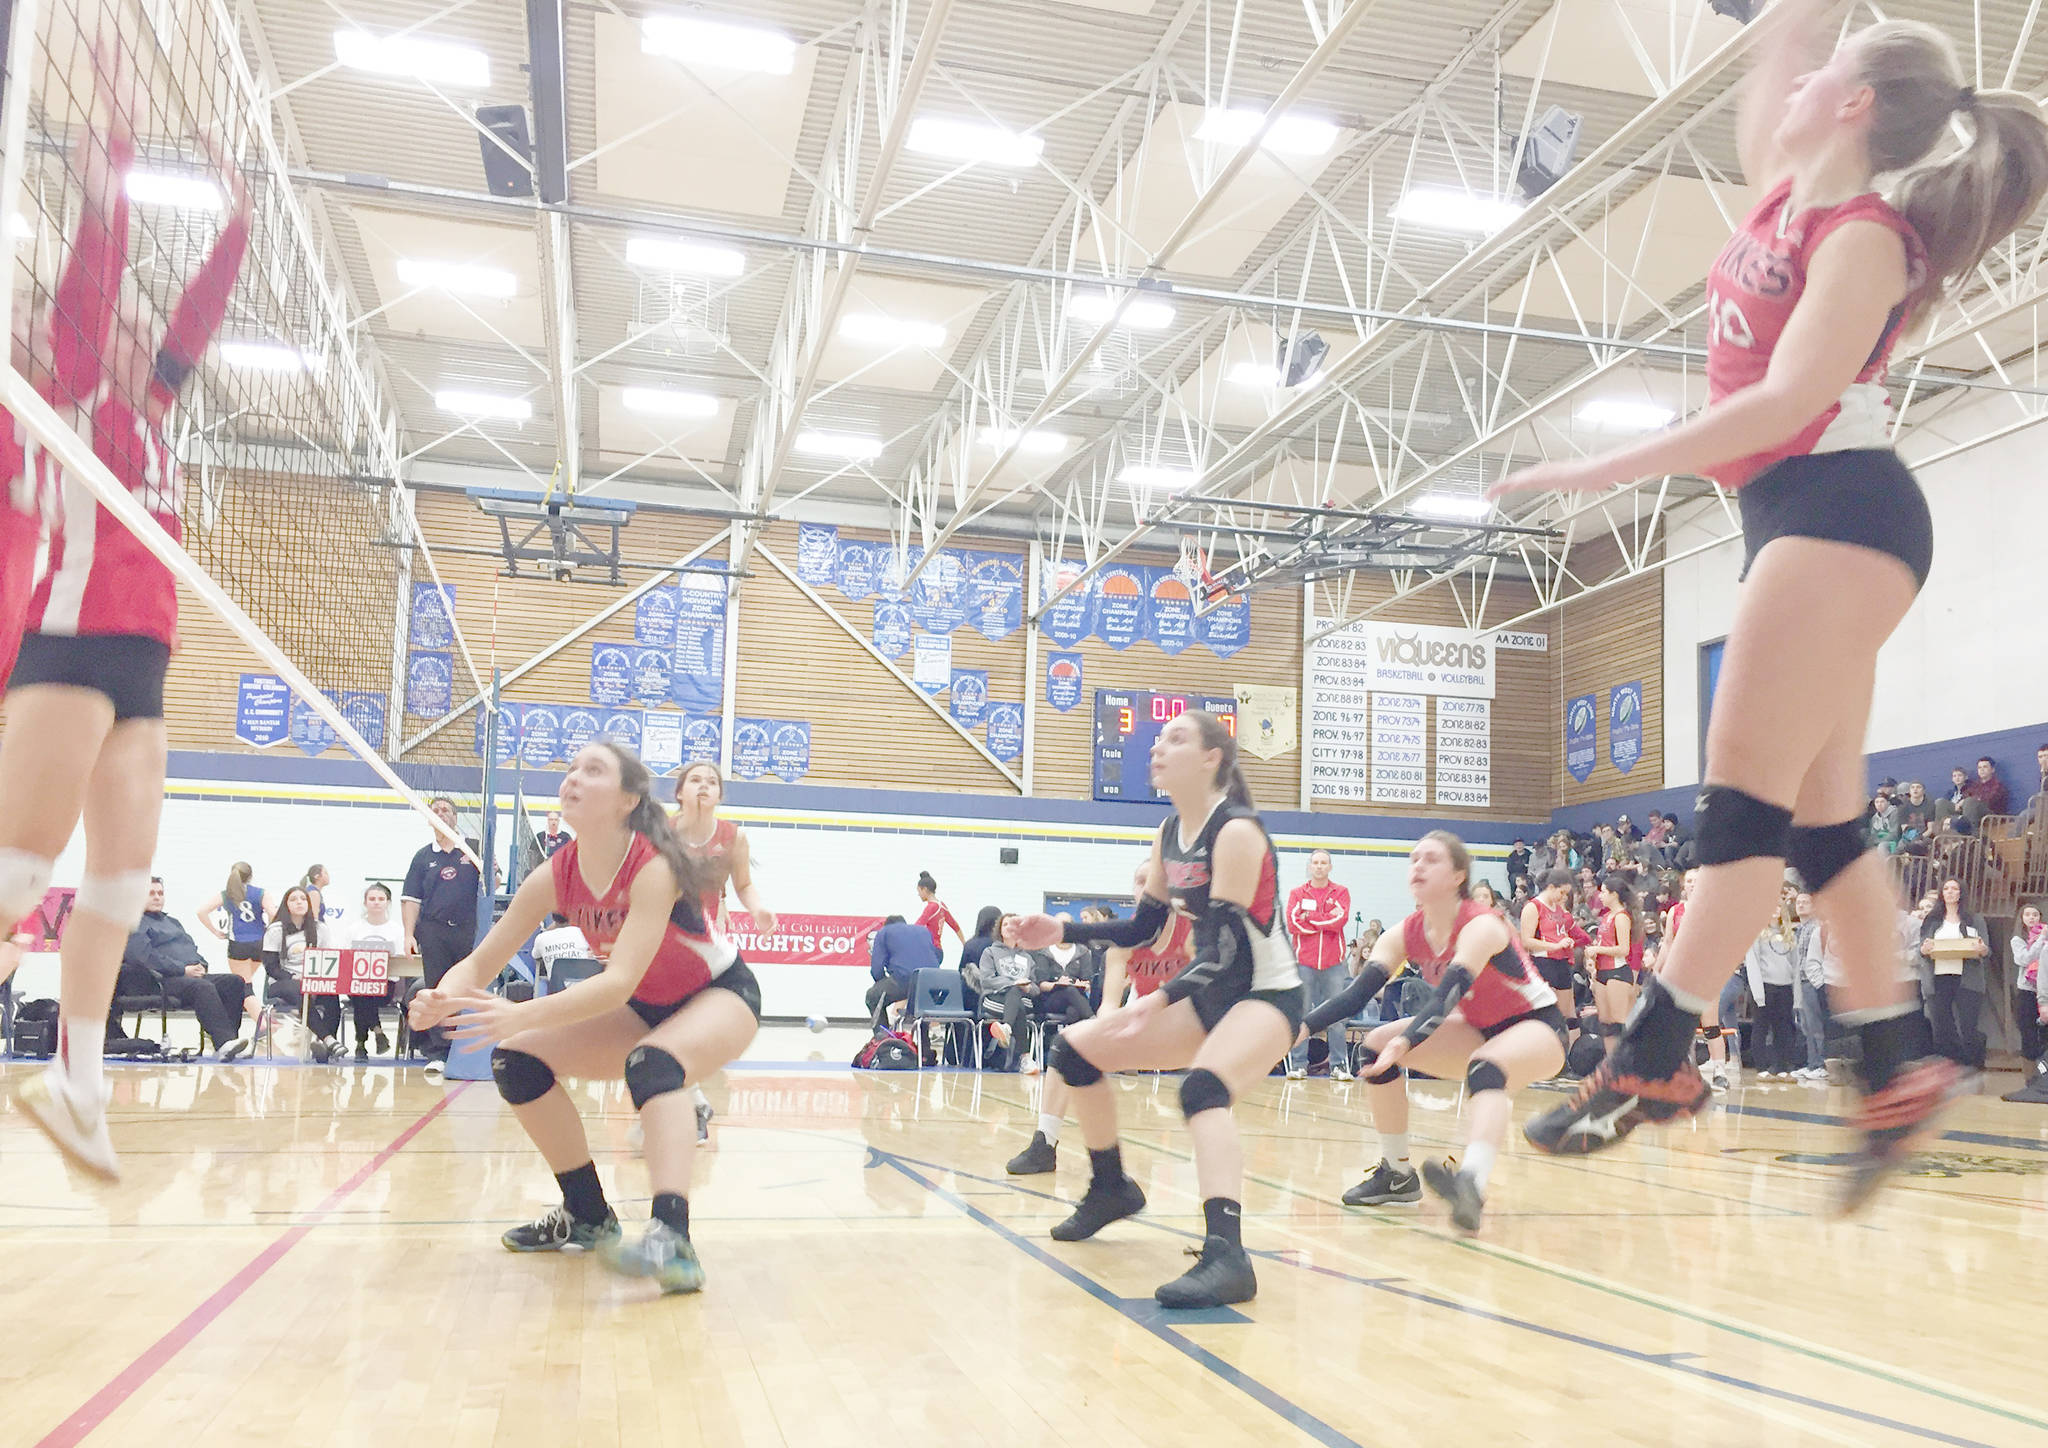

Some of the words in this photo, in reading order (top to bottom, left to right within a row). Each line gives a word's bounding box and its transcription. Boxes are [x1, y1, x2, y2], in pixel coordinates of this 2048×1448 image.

[1495, 634, 1509, 644] AA
[1511, 636, 1534, 647] ZONE
[1376, 634, 1486, 669] VIQUEENS
[1316, 656, 1340, 667] ZONE
[1376, 668, 1424, 681] BASKETBALL
[1441, 673, 1486, 685] VOLLEYBALL
[1105, 694, 1129, 706] Home
[1316, 692, 1340, 703] ZONE
[1377, 696, 1401, 707] ZONE
[1442, 701, 1466, 712] ZONE
[1119, 708, 1133, 733] 3
[1312, 710, 1337, 721] ZONE
[1441, 719, 1465, 730] ZONE
[1377, 733, 1401, 744] ZONE
[1440, 736, 1463, 747] ZONE
[1312, 747, 1337, 758] CITY
[1377, 750, 1401, 761] ZONE
[1375, 768, 1399, 780] ZONE
[1437, 771, 1461, 783] ZONE
[1312, 783, 1336, 795] ZONE
[1376, 787, 1400, 798] ZONE
[239, 900, 256, 923] 8
[791, 922, 859, 935] COLLEGIATE
[1555, 923, 1567, 937] 14
[545, 942, 576, 953] MINOR
[819, 936, 856, 954] GO!
[307, 956, 339, 976] 17
[354, 957, 387, 977] 06
[301, 978, 337, 994] HOME
[350, 979, 387, 995] GUEST
